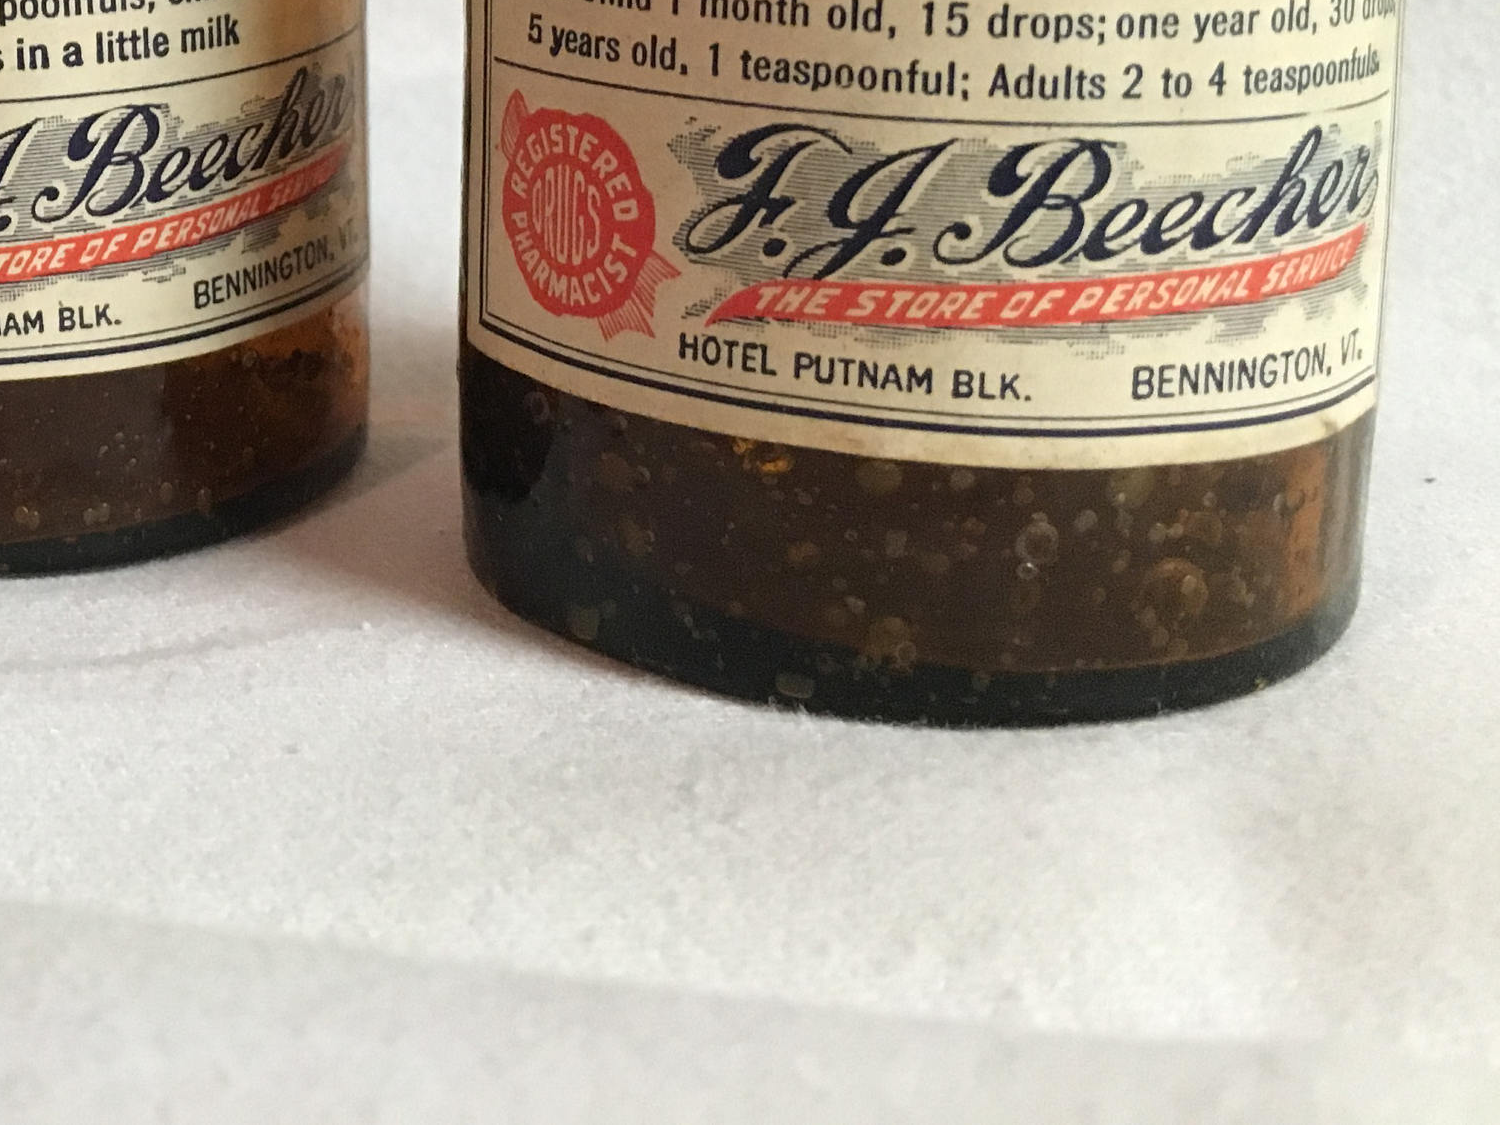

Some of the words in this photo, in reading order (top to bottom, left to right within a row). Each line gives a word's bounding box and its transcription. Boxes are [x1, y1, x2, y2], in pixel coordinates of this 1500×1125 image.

[16, 37, 50, 71] in
[61, 41, 85, 69] a
[95, 25, 171, 65] little
[180, 13, 241, 54] milk
[527, 12, 543, 45] 5
[550, 24, 621, 63] years
[708, 41, 720, 78] 1
[740, 48, 971, 101] teaspoonful;
[988, 63, 1106, 102] Adults
[1121, 62, 1144, 100] 2
[1161, 66, 1194, 98] to
[1208, 60, 1228, 97] 4
[922, 0, 970, 38] 15
[987, 2, 1107, 46] drops;
[1116, 9, 1180, 40] one
[1193, 7, 1261, 44] year
[510, 123, 640, 222] REGISTERED
[932, 124, 1379, 268] Beecher
[78, 233, 128, 264] OF
[130, 195, 261, 255] PERSONAL
[531, 163, 601, 267] DRUGS
[510, 211, 637, 307] PHARMACIST
[753, 285, 841, 317] THE
[845, 288, 998, 321] STORE
[1000, 287, 1066, 319] OF
[1068, 267, 1251, 317] PERSONAL
[1260, 237, 1353, 295] SERVICE
[57, 303, 123, 332] BLK.
[1341, 326, 1363, 367] VT.
[678, 332, 777, 377] HOTEL
[793, 351, 933, 395] PUTNAM
[951, 369, 1033, 402] BLK.
